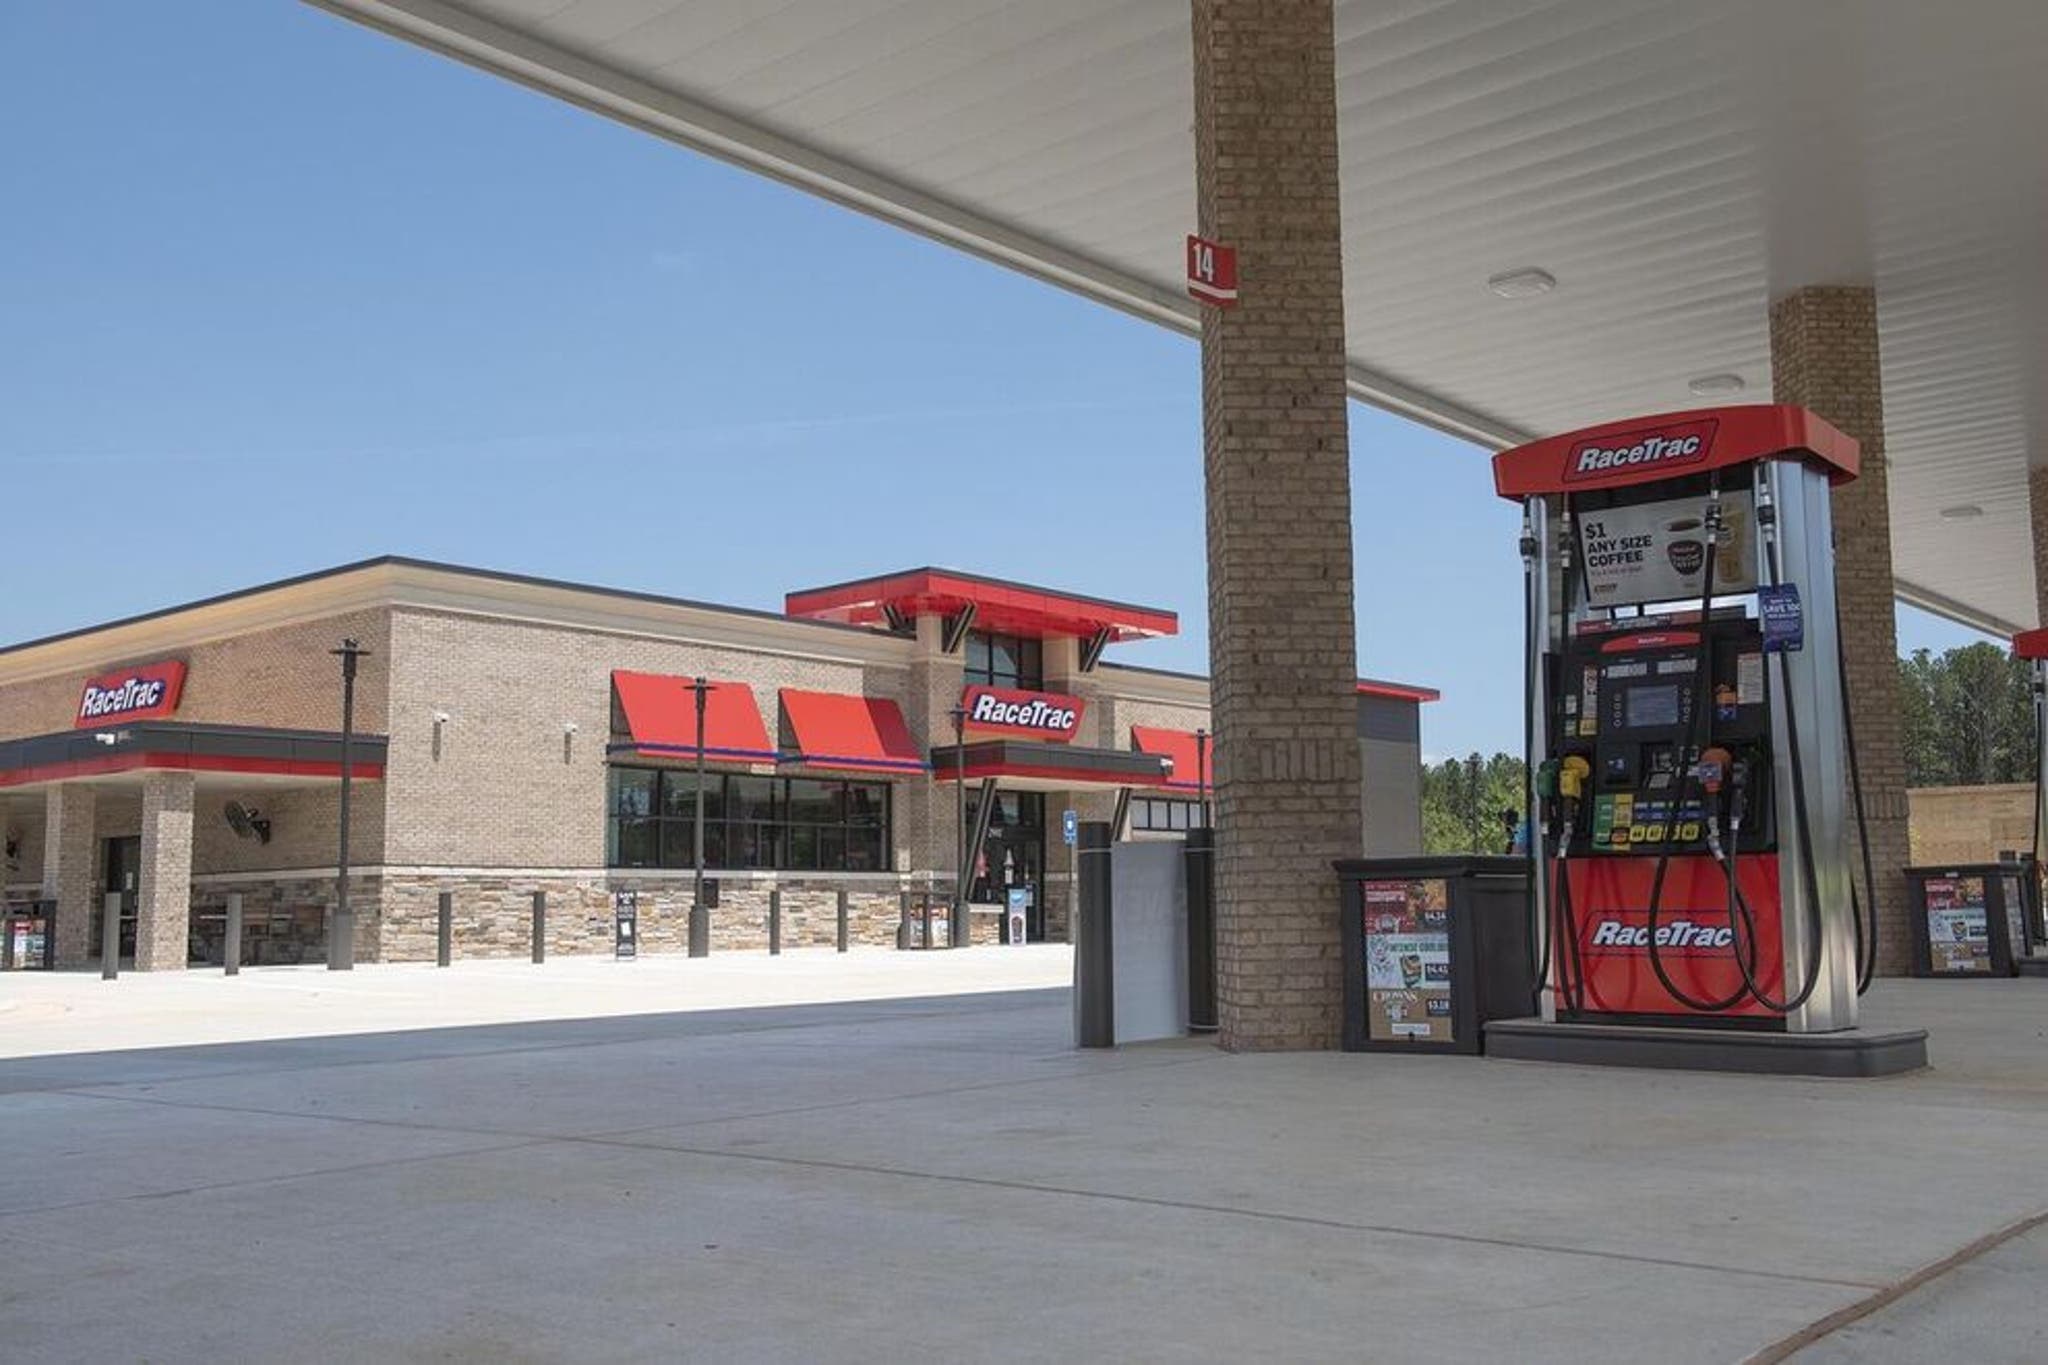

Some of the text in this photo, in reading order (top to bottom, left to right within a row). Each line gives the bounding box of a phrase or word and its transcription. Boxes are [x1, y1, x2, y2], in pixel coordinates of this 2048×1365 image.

[1193, 242, 1213, 282] 14
[1577, 436, 1700, 471] RaceTrac
[1585, 522, 1606, 539] $1
[1588, 535, 1652, 554] ANY SIZE
[1589, 550, 1643, 567] COFFEE
[80, 678, 160, 717] RaceTrac
[974, 694, 1075, 729] RaceTrac
[1593, 921, 1732, 946] RaceTrac
